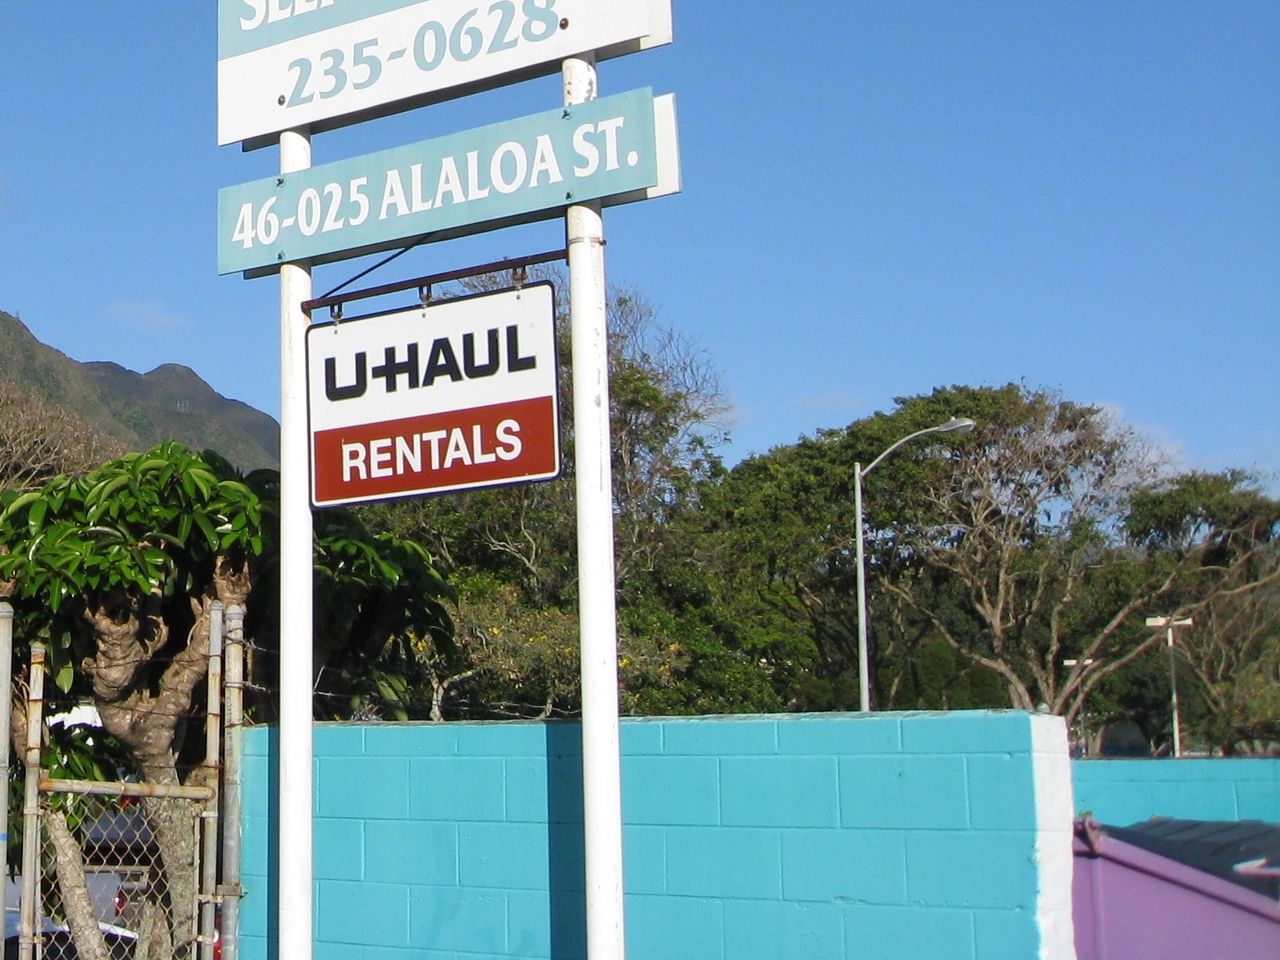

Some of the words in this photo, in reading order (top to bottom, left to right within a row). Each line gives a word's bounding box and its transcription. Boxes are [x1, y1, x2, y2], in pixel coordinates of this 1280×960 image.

[231, 176, 370, 248] 46-025
[378, 132, 564, 221] ALALOA
[568, 116, 639, 178] ST.
[324, 325, 536, 402] U-HAUL
[341, 419, 522, 483] RENTALS
